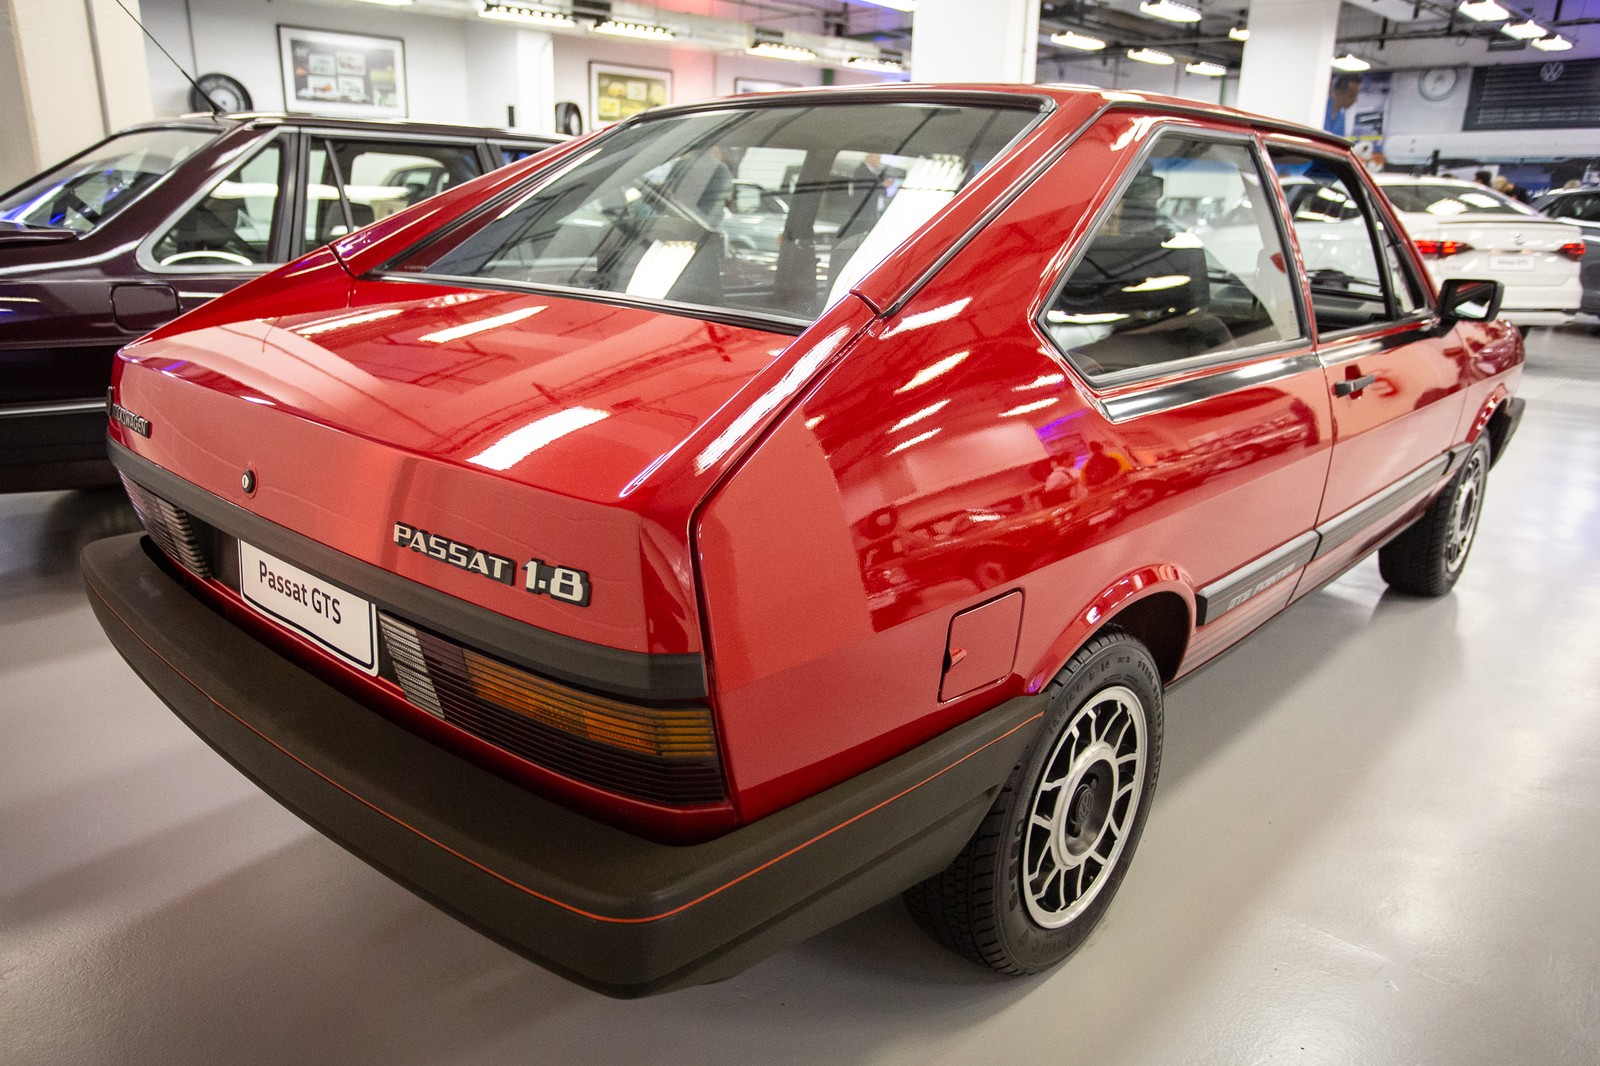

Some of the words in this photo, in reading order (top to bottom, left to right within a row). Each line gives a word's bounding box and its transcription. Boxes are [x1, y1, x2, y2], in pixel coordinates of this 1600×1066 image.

[111, 403, 148, 437] LKSWAGEN
[259, 560, 308, 607] Passat
[312, 588, 341, 624] GTS
[393, 522, 512, 582] PASSAT
[523, 558, 587, 606] 1.8
